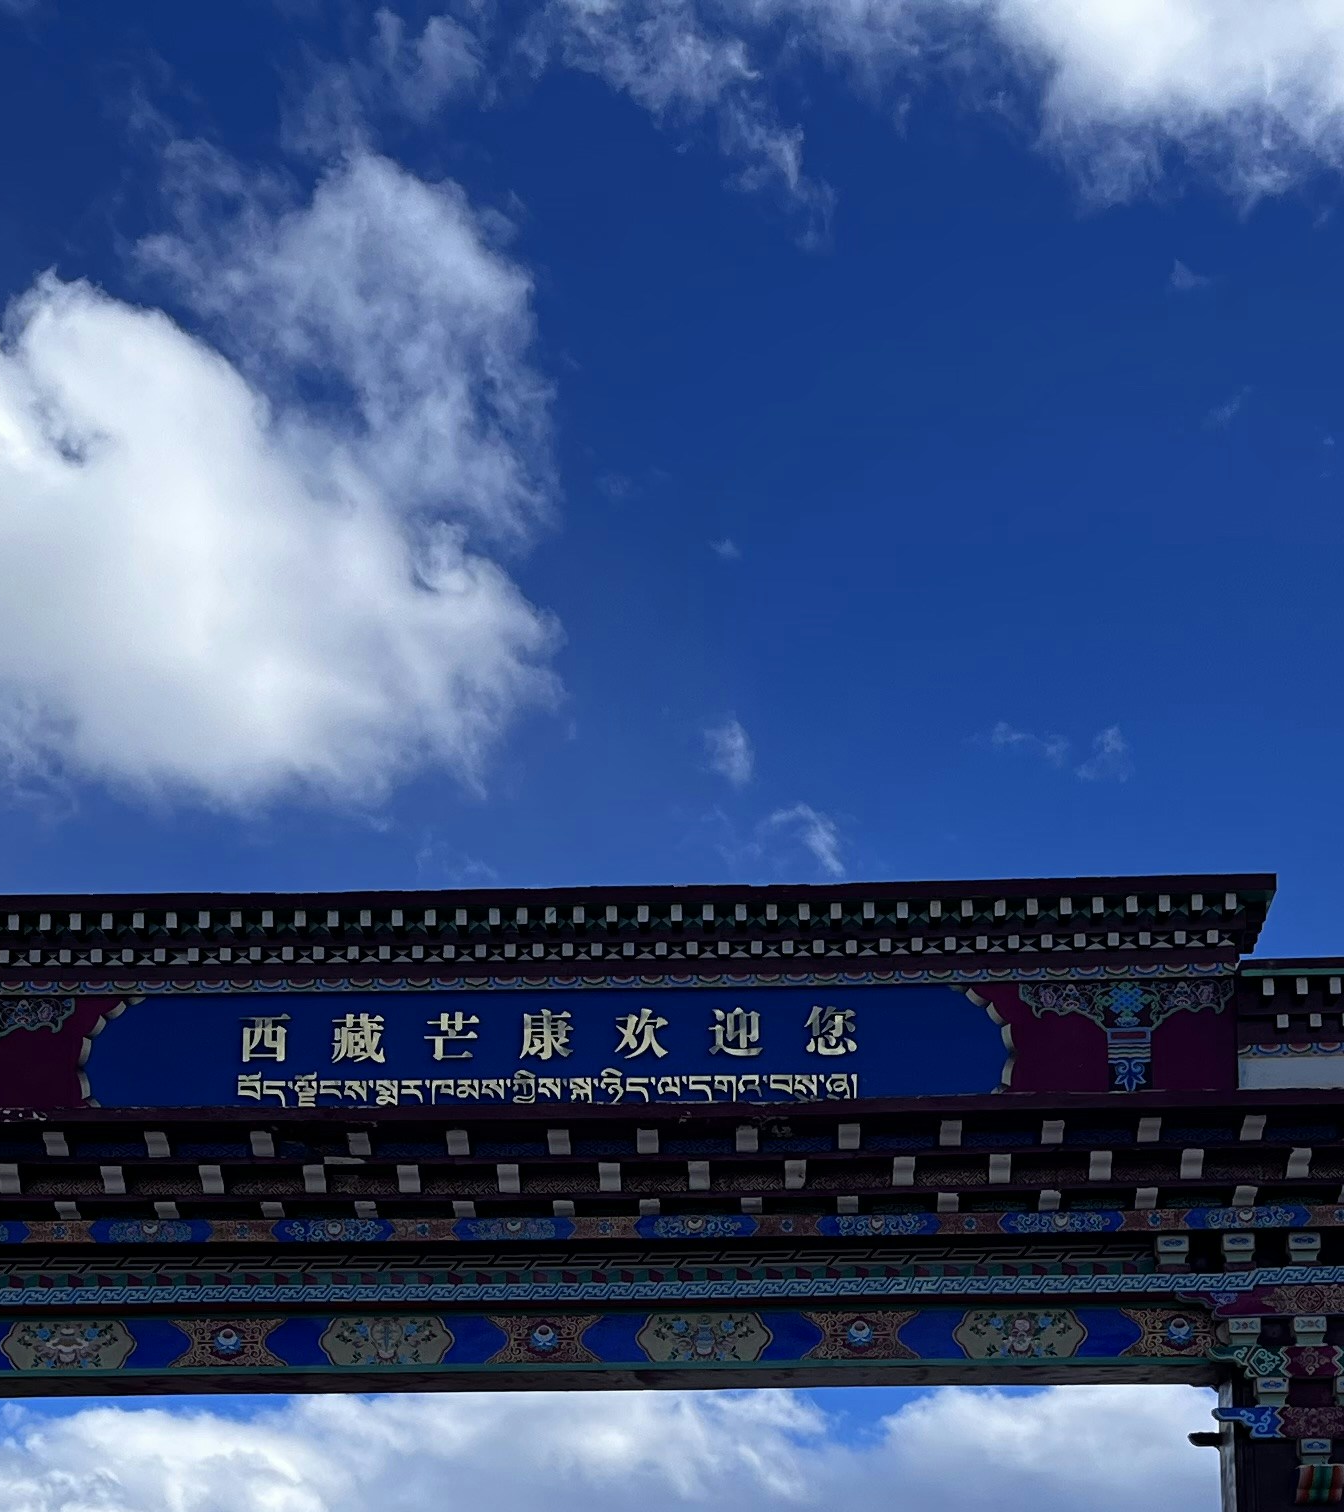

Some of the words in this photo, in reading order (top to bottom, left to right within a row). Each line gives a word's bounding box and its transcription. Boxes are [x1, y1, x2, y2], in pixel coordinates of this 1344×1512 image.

[239, 1005, 858, 1064] 西藏芒康欢迎您
